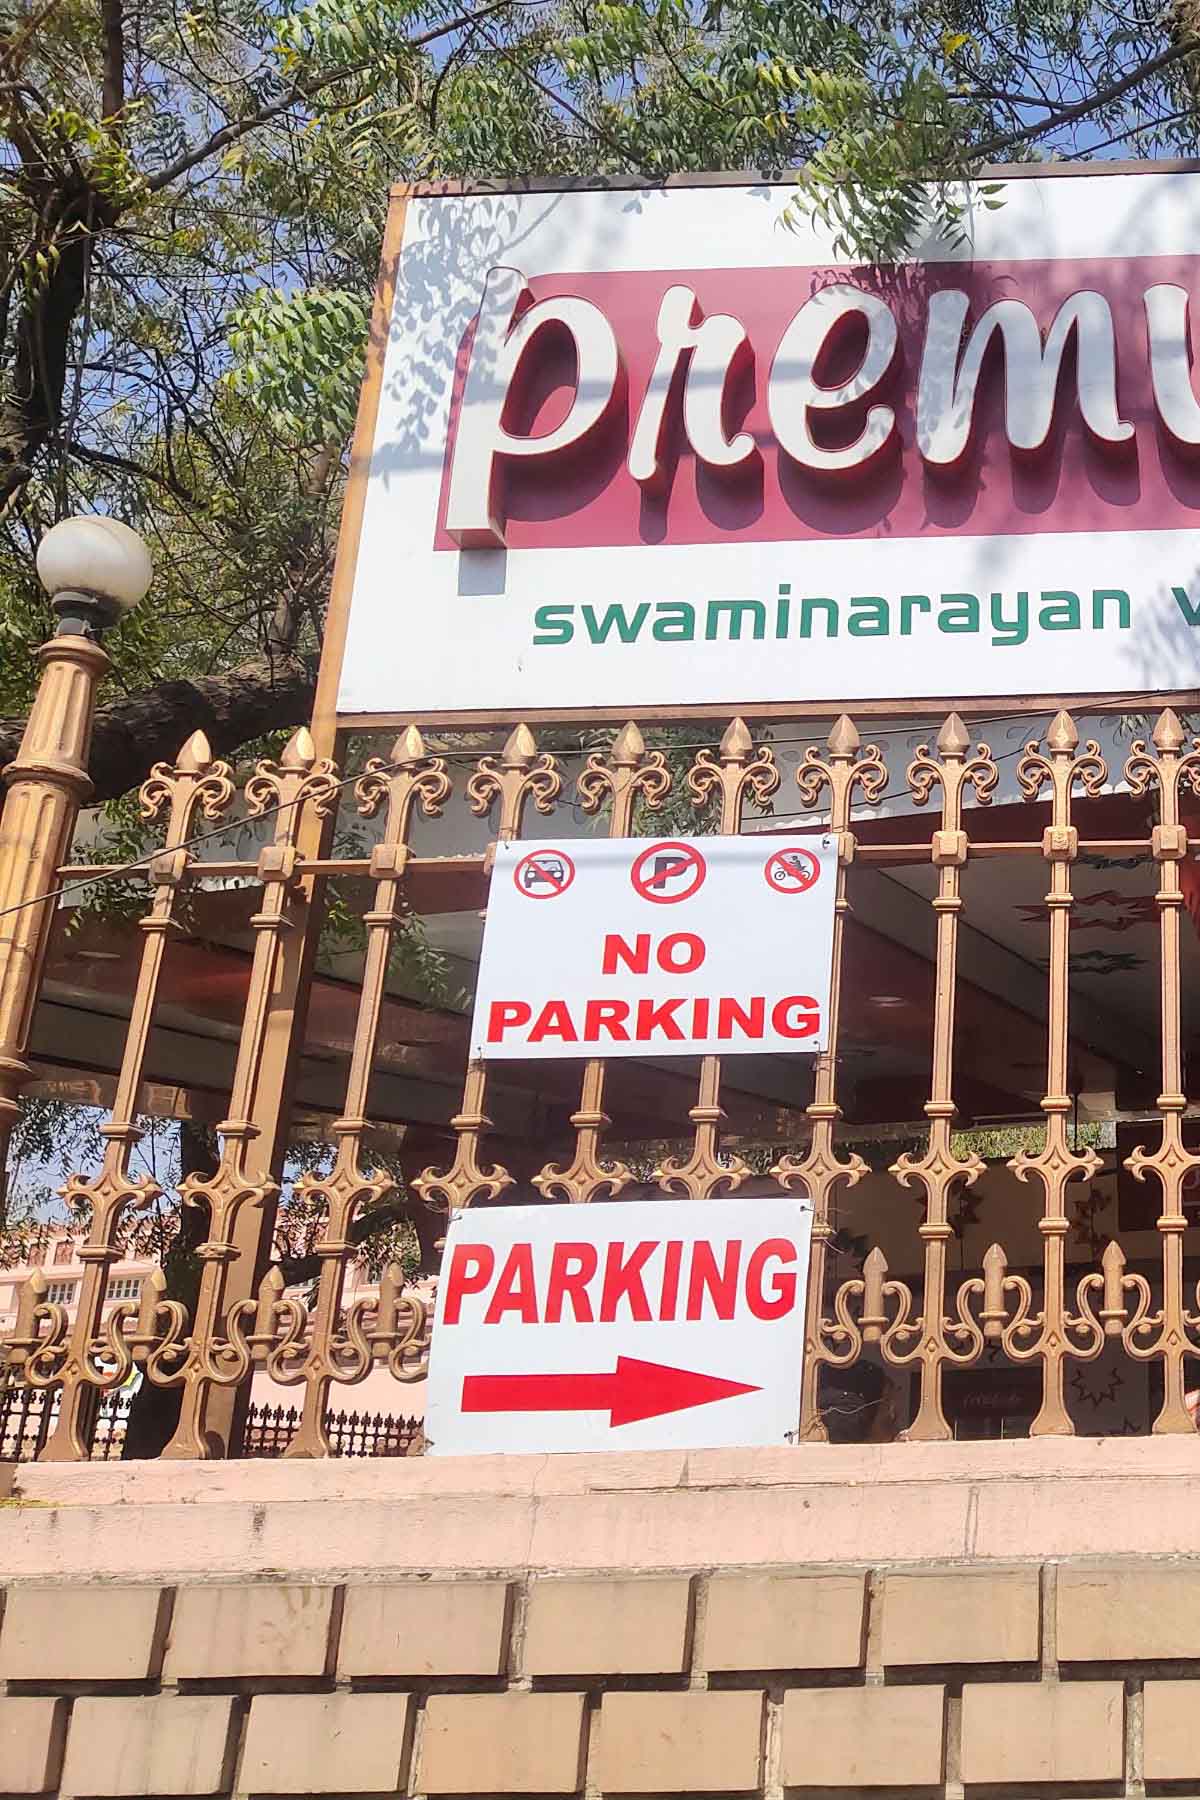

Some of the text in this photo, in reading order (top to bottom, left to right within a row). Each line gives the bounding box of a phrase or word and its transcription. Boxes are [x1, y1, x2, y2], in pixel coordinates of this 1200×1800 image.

[533, 583, 1131, 647] swaminarayan
[653, 856, 687, 889] P
[601, 932, 706, 975] NO
[486, 995, 821, 1044] PARKING
[442, 1237, 798, 1326] PARKING
